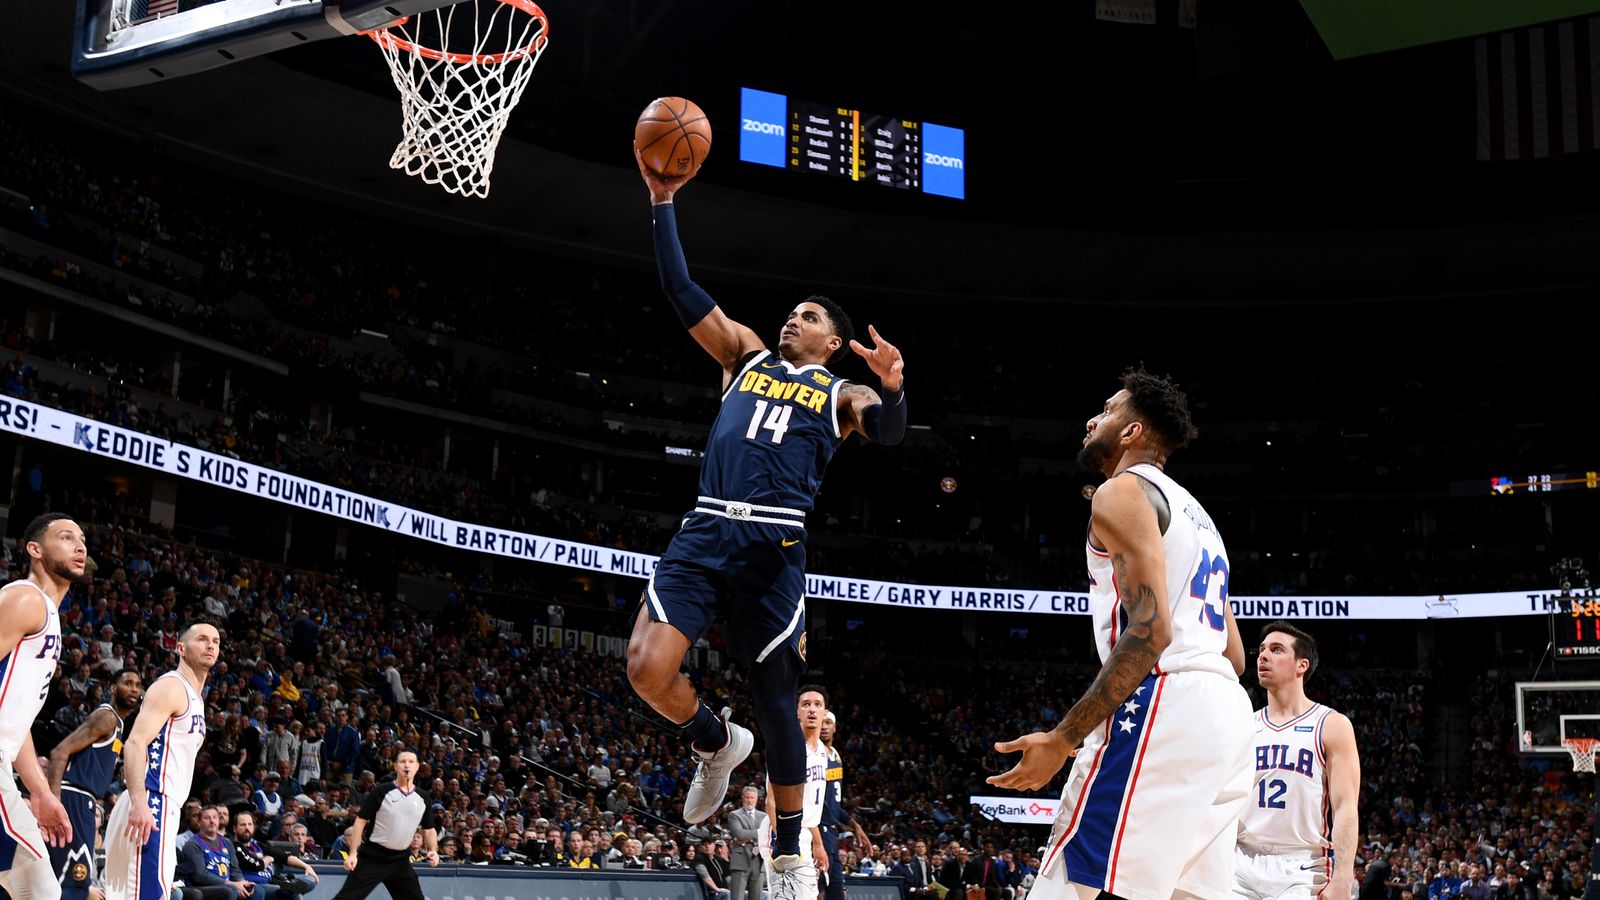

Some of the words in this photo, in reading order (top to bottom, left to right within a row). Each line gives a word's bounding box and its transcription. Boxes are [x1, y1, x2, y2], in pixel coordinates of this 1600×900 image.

[742, 119, 785, 136] zoom
[924, 152, 963, 170] zoom
[739, 370, 828, 414] DENVER
[746, 399, 793, 444] 14
[199, 456, 249, 489] KIDS
[411, 514, 448, 542] WILL
[1051, 595, 1090, 613] CRO
[1190, 548, 1230, 632] 43
[1256, 744, 1313, 779] HILA
[815, 788, 820, 805] 1
[834, 781, 842, 803] 3
[1259, 779, 1287, 809] 12
